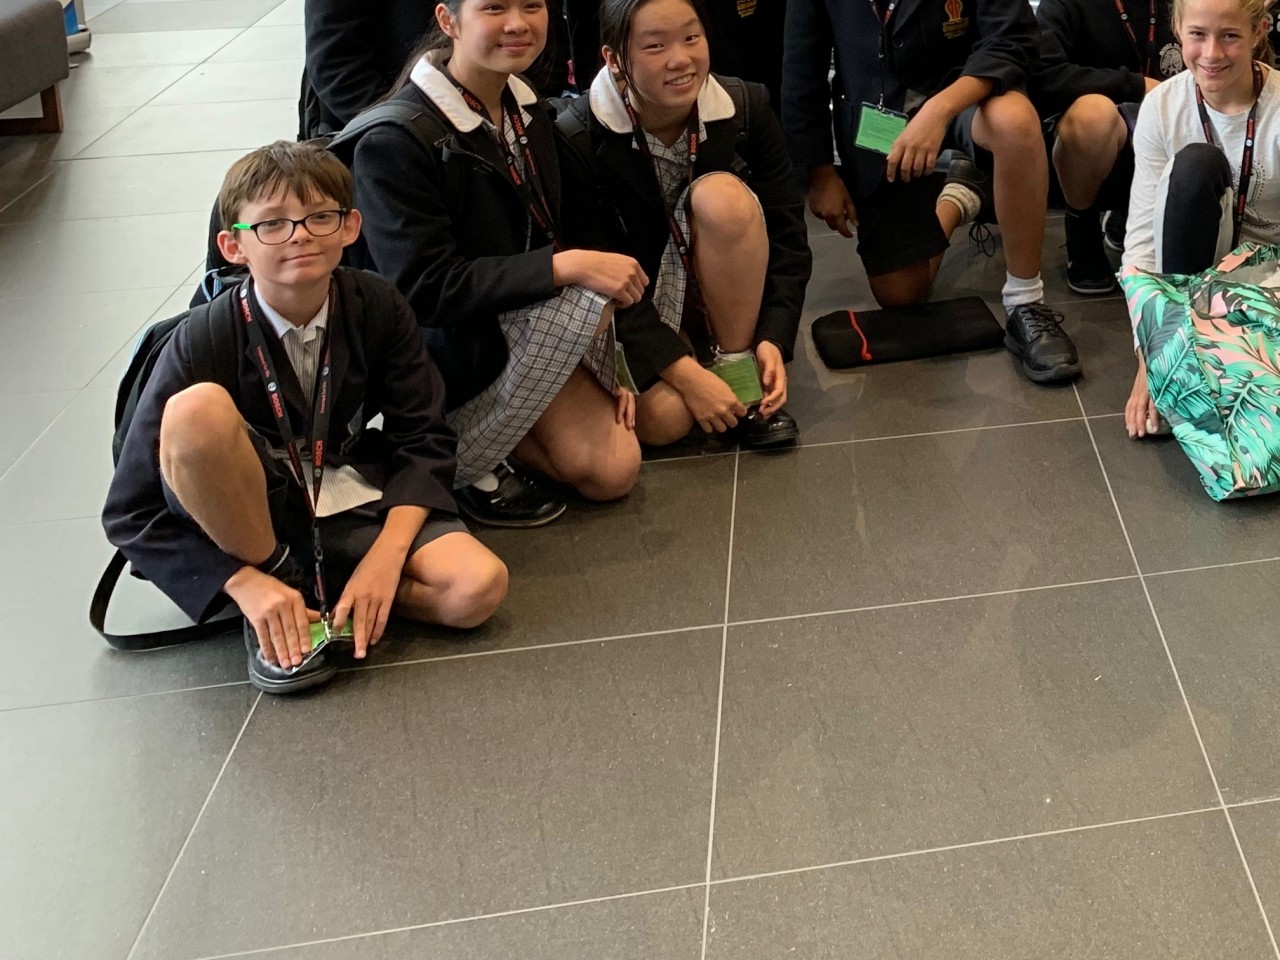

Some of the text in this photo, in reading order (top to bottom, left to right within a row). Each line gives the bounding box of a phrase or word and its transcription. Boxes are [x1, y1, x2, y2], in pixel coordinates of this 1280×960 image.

[512, 114, 524, 135] BOSCH
[241, 298, 252, 322] BOSCH
[271, 393, 283, 418] BOSCH
[315, 440, 323, 466] BOSCH
